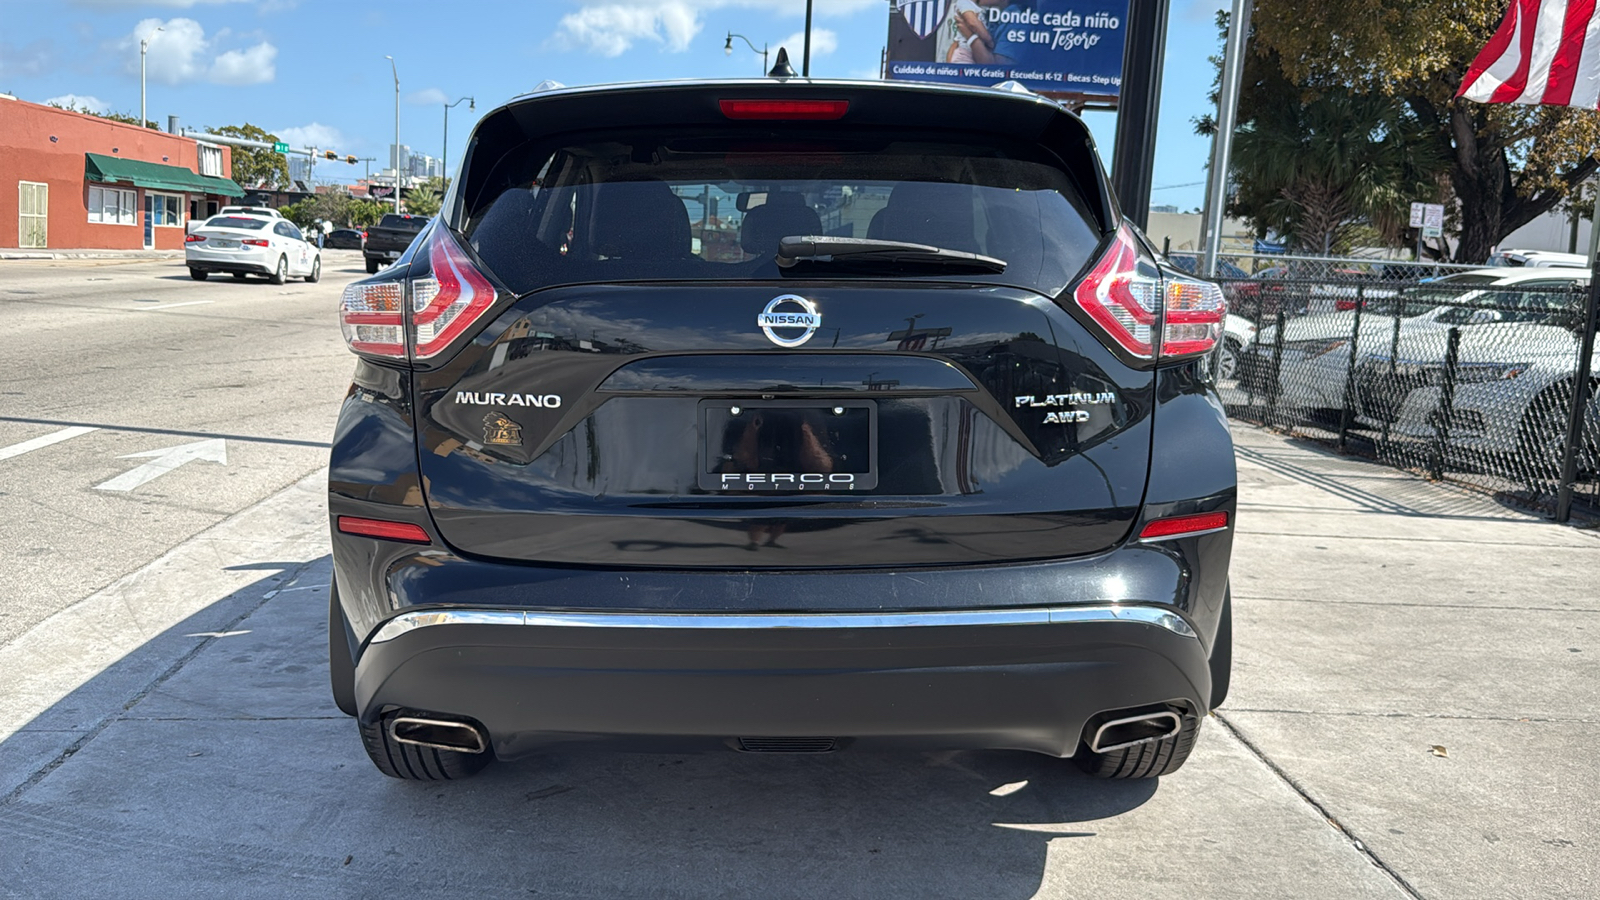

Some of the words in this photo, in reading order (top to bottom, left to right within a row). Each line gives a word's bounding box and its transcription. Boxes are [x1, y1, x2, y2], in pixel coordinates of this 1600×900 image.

[988, 7, 1039, 25] Donde
[1043, 10, 1081, 27] cada
[1084, 11, 1120, 29] niño
[1007, 29, 1026, 42] es
[1030, 30, 1050, 43] un
[1051, 27, 1100, 51] Tesoro
[893, 65, 924, 75] Cuidado
[926, 66, 935, 75] de
[937, 67, 958, 76] niños
[964, 69, 981, 77] VPK
[981, 68, 1004, 78] Gratis
[1010, 70, 1043, 80] Escuelas
[1045, 73, 1062, 81] K-12
[1068, 74, 1090, 83] Becas
[1092, 75, 1110, 86] Step
[1111, 77, 1121, 87] Up
[764, 315, 814, 324] NISSAN
[455, 391, 561, 408] MURANO
[1014, 392, 1116, 408] PLATINUM
[1042, 410, 1090, 424] AWD
[721, 473, 854, 483] FERCO
